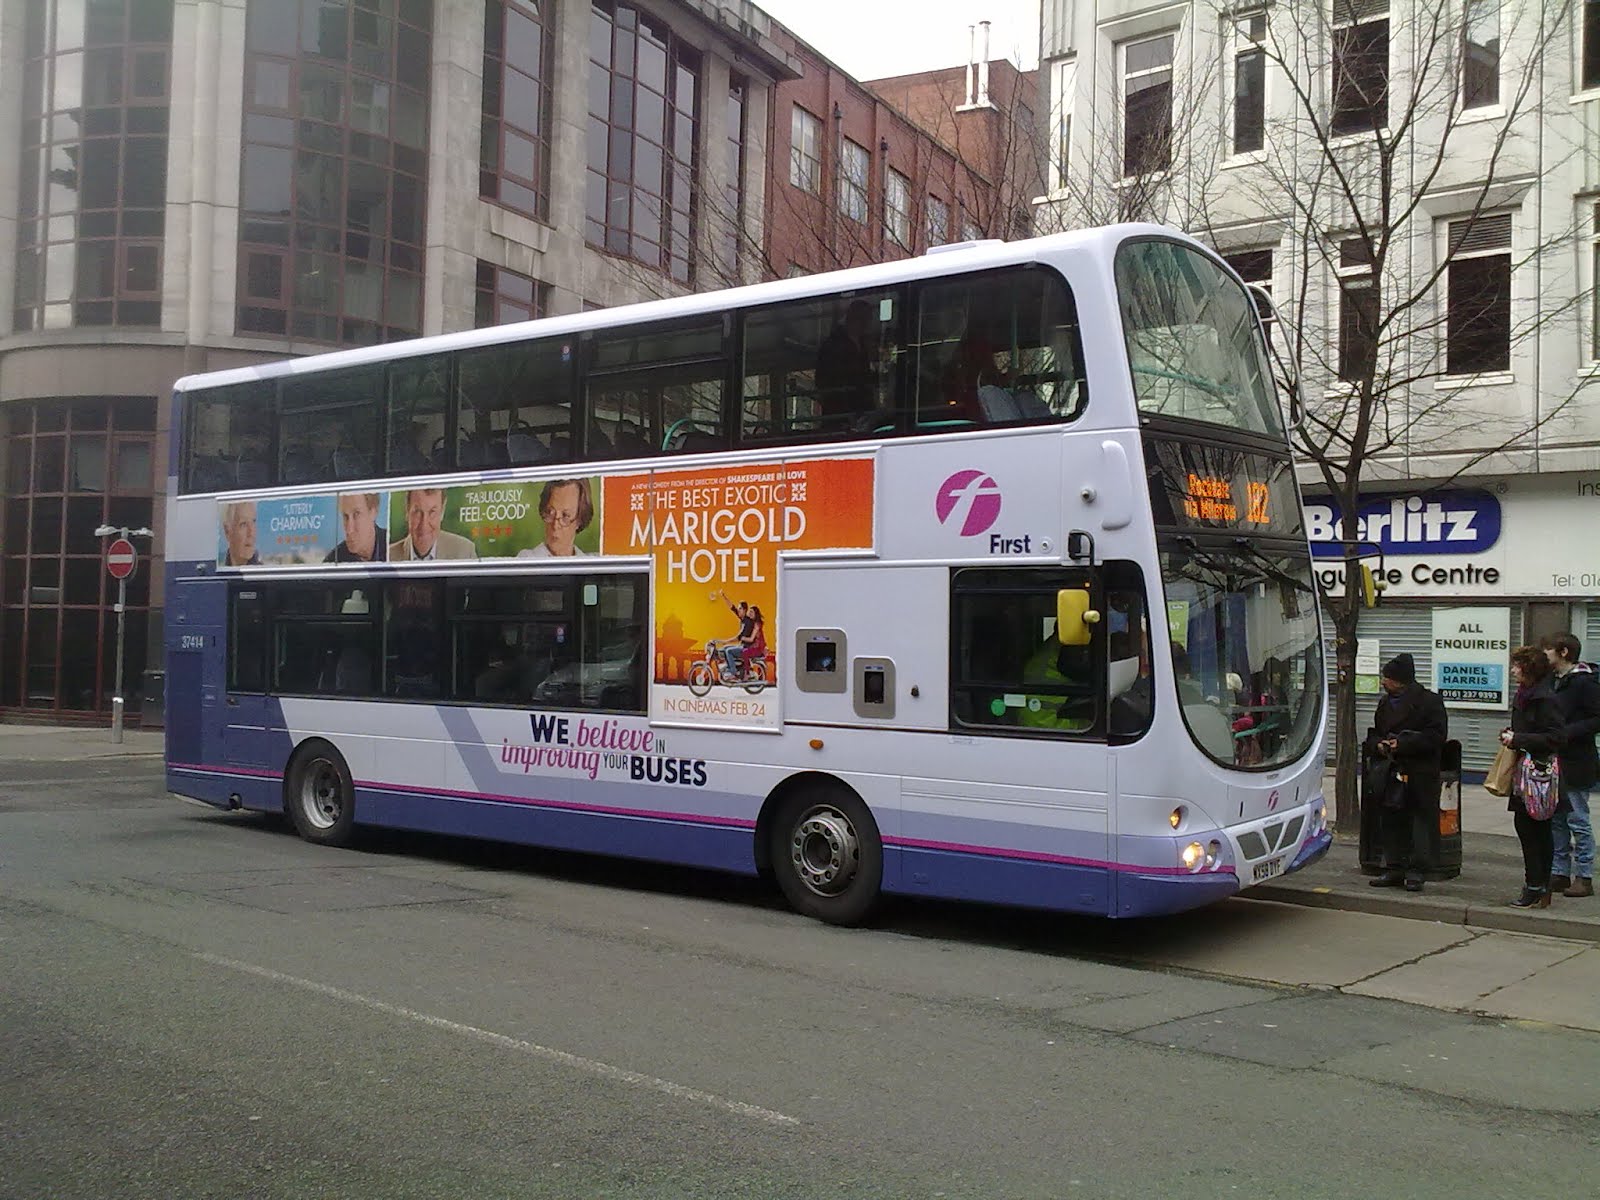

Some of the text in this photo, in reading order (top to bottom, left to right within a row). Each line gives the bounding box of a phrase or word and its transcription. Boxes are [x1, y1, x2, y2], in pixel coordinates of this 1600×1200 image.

[727, 473, 775, 484] SHAKESPEARE
[776, 472, 786, 481] IN
[787, 470, 807, 480] LOVE
[647, 483, 787, 510] THE BEST EXOTIC
[630, 505, 807, 547] MARIGOLD
[1304, 496, 1478, 542] Berlitz
[989, 534, 1032, 554] First
[667, 548, 765, 584] HOTEL
[1411, 563, 1500, 586] Centre
[1552, 574, 1575, 587] Tel:
[1458, 623, 1483, 633] ALL
[1435, 639, 1508, 650] ENQUIRIES
[1442, 666, 1488, 676] DANIEL
[1442, 676, 1488, 685] HARRIS
[1442, 690, 1461, 698] 0161
[664, 698, 765, 716] IN CINEMAS FEB 24
[529, 713, 666, 754] WE believe IN
[501, 737, 708, 787] improving YOUR BUSES
